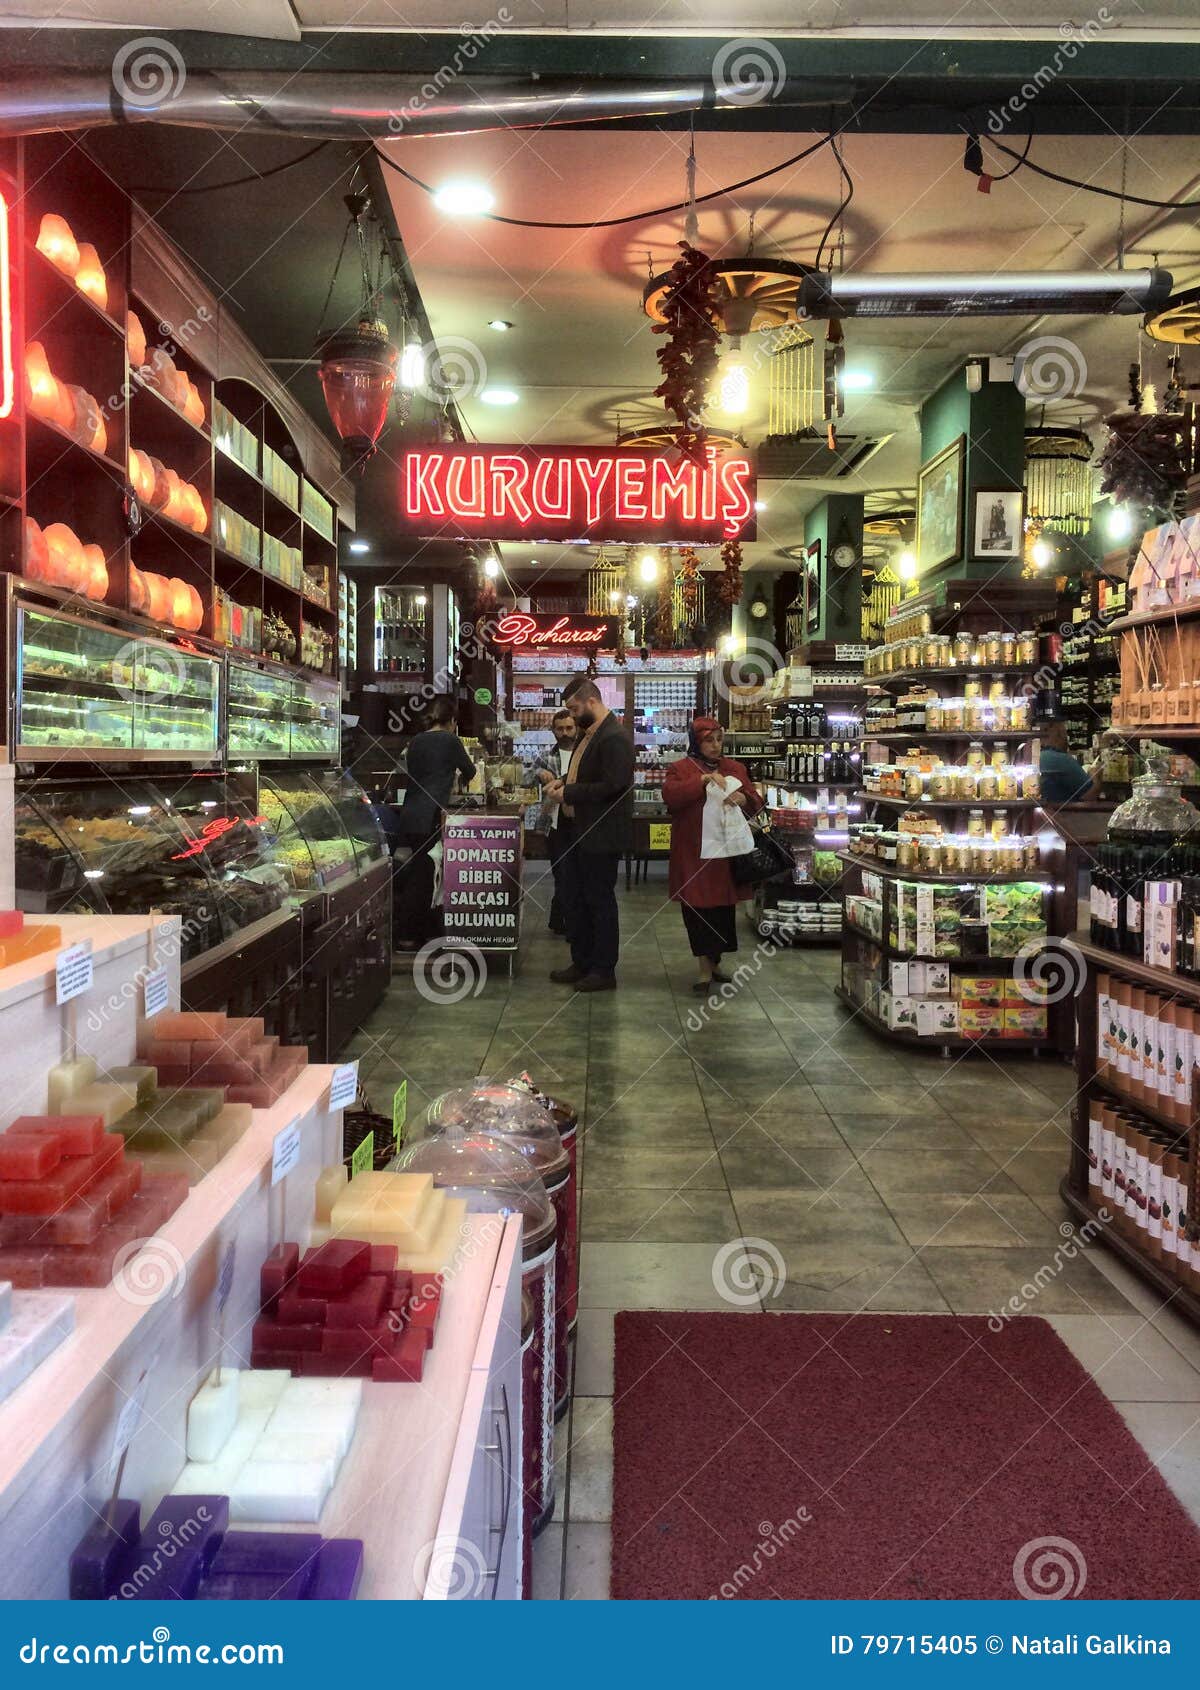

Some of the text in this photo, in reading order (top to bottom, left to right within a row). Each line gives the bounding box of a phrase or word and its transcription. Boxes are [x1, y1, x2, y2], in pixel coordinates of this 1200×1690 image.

[405, 447, 752, 534] KURUYEMİŞ
[492, 614, 608, 646] Baharat
[448, 827, 516, 839] ÖZEL YAPIM
[447, 848, 515, 863] DOMATES
[459, 866, 502, 884] BİBER
[450, 891, 509, 909] SALÇASI
[444, 913, 515, 928] BULUNUR
[446, 935, 461, 943] CAN
[462, 936, 492, 944] LOKMAN
